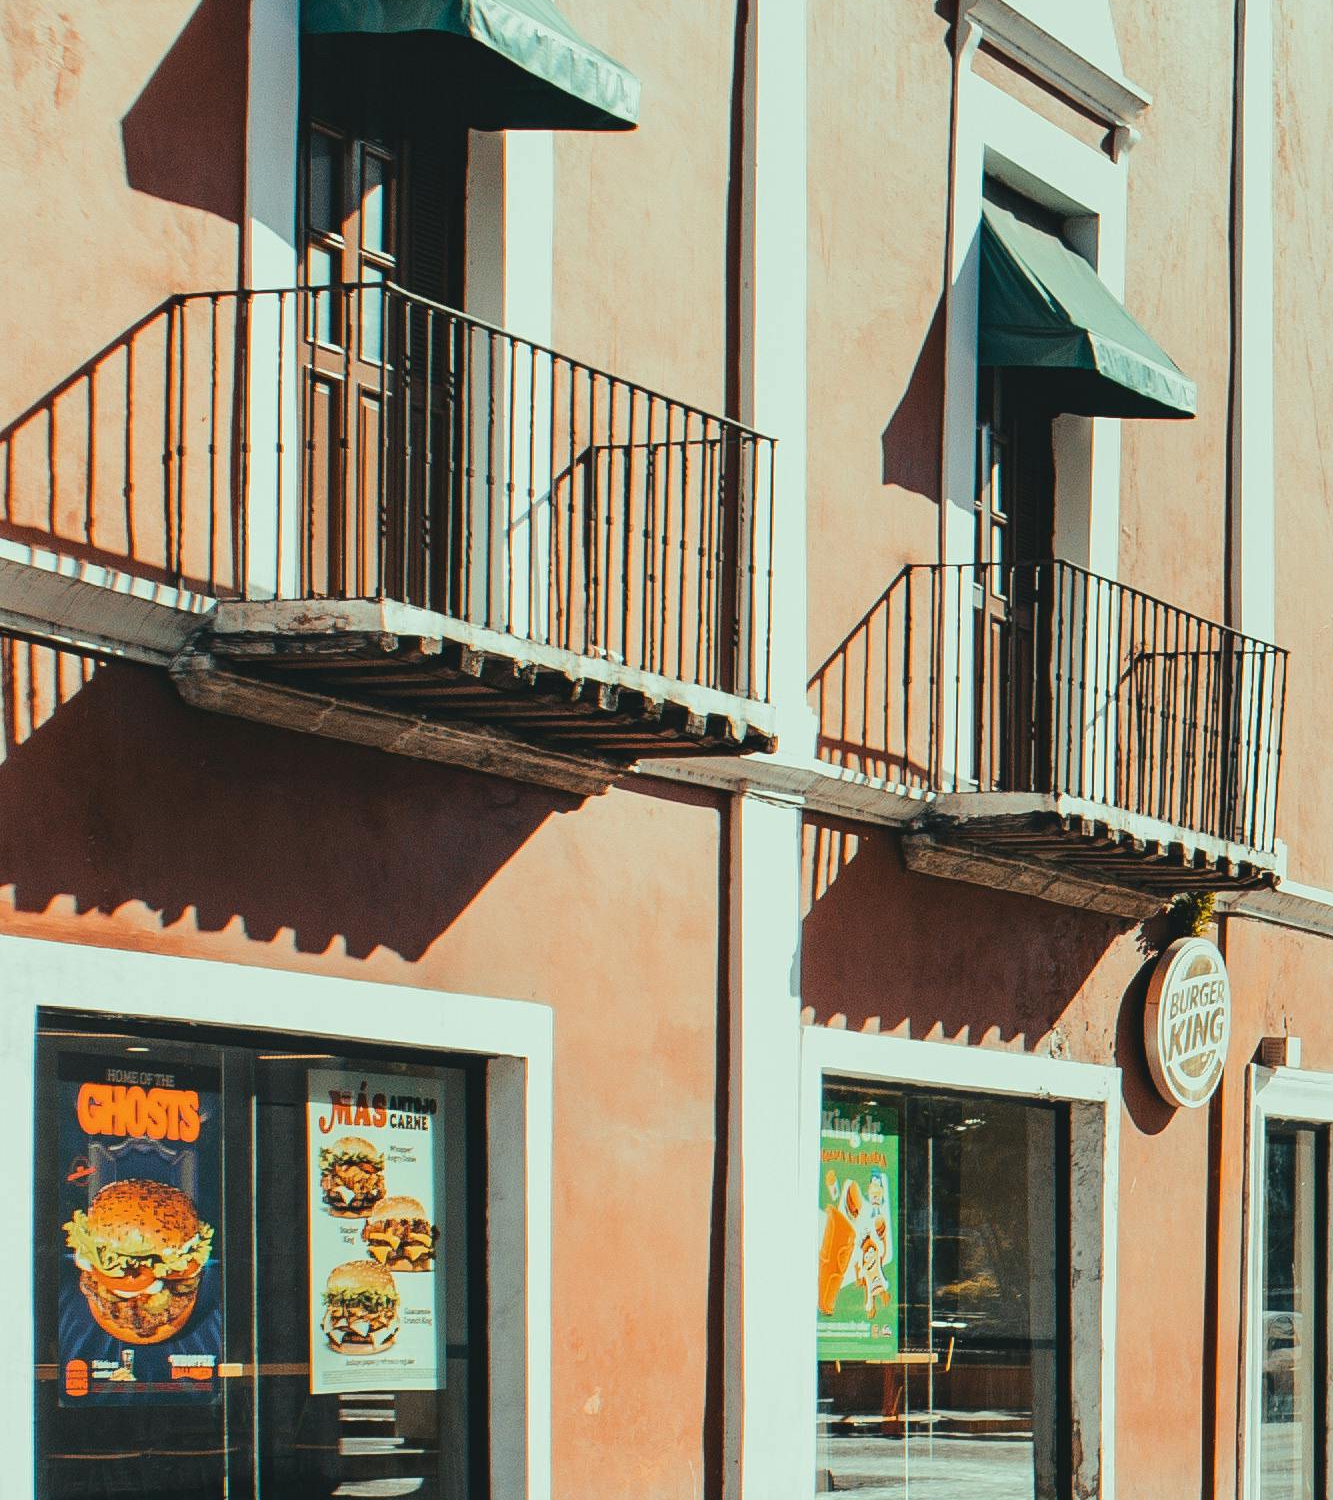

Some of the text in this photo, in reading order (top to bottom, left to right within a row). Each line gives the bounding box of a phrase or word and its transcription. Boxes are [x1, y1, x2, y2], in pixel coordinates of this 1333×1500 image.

[1170, 980, 1225, 1020] BURGER
[1168, 1007, 1225, 1061] KING
[108, 1069, 176, 1088] HOME OF THE
[77, 1082, 201, 1143] GHOSTS
[319, 1079, 387, 1134] MÁS
[389, 1113, 429, 1131] CARNE
